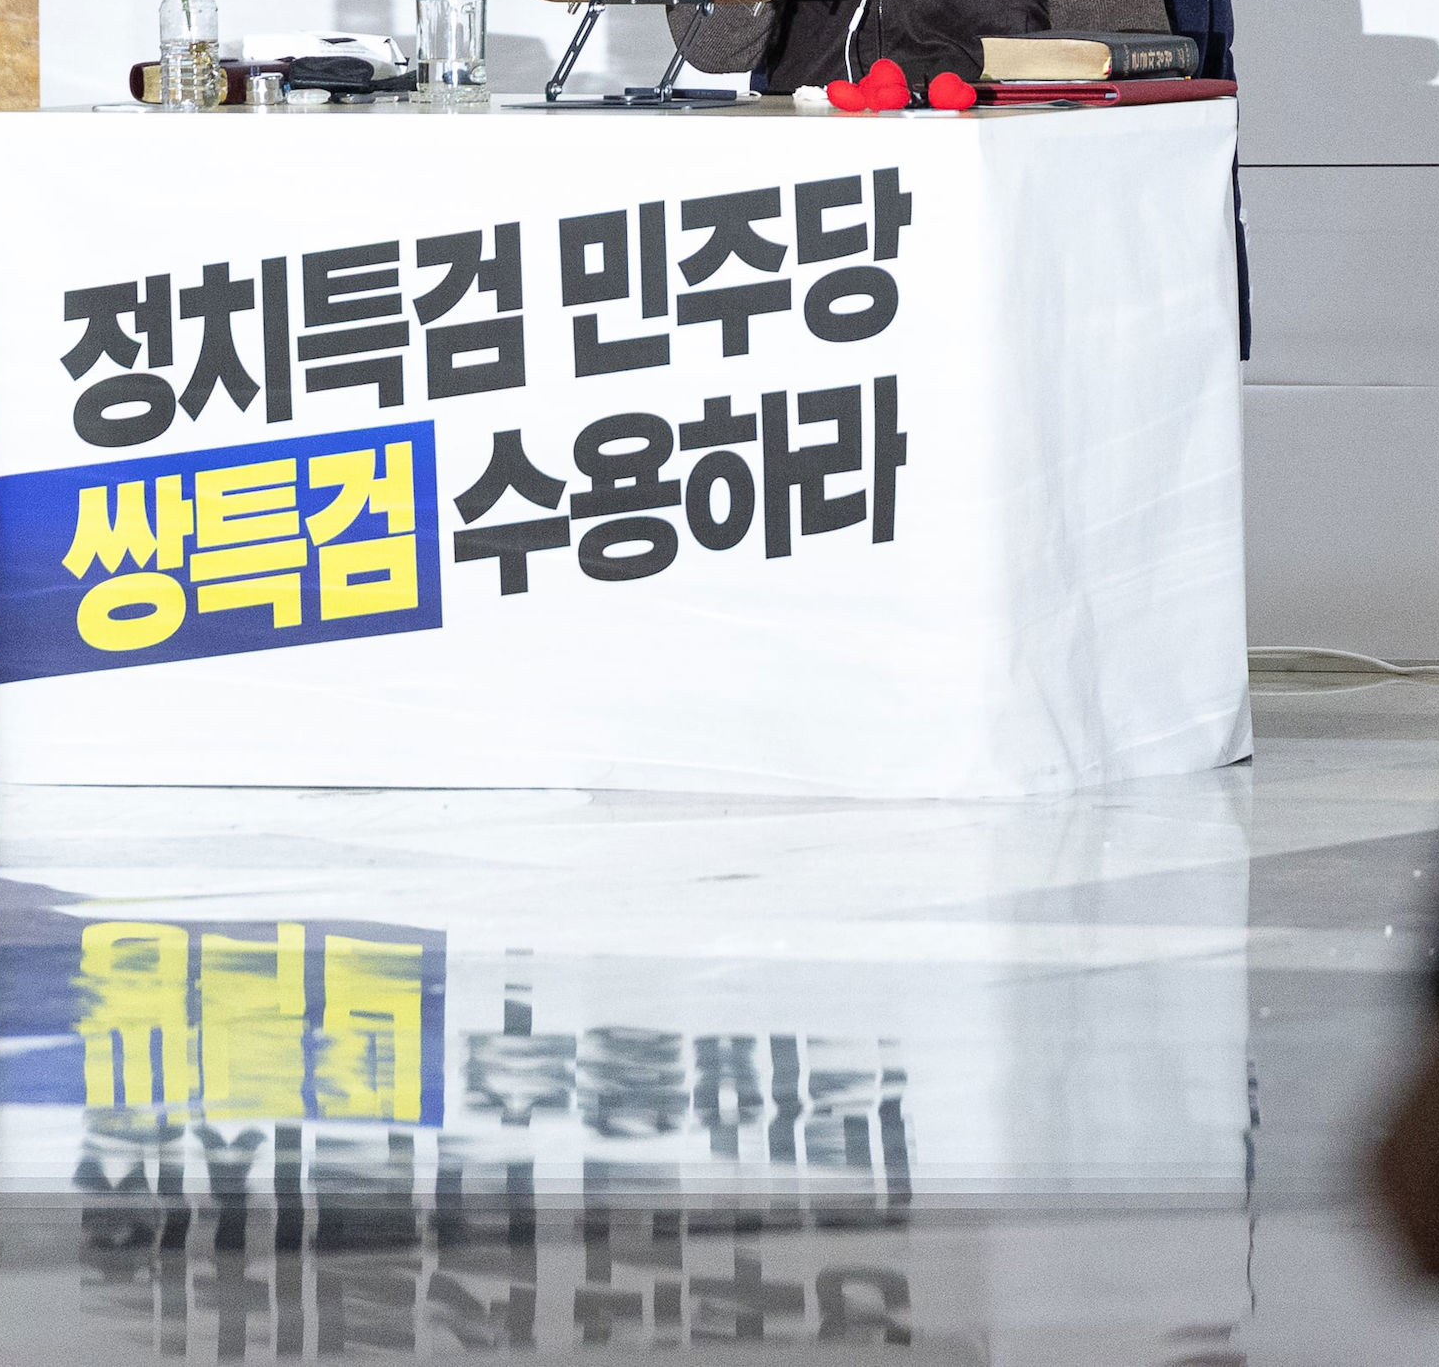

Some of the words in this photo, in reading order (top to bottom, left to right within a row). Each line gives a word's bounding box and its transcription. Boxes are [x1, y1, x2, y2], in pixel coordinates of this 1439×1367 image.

[59, 221, 527, 449] 정치특검
[558, 165, 913, 378] 민주당
[61, 441, 419, 654] 쌍특검
[452, 374, 908, 597] 수용하라
